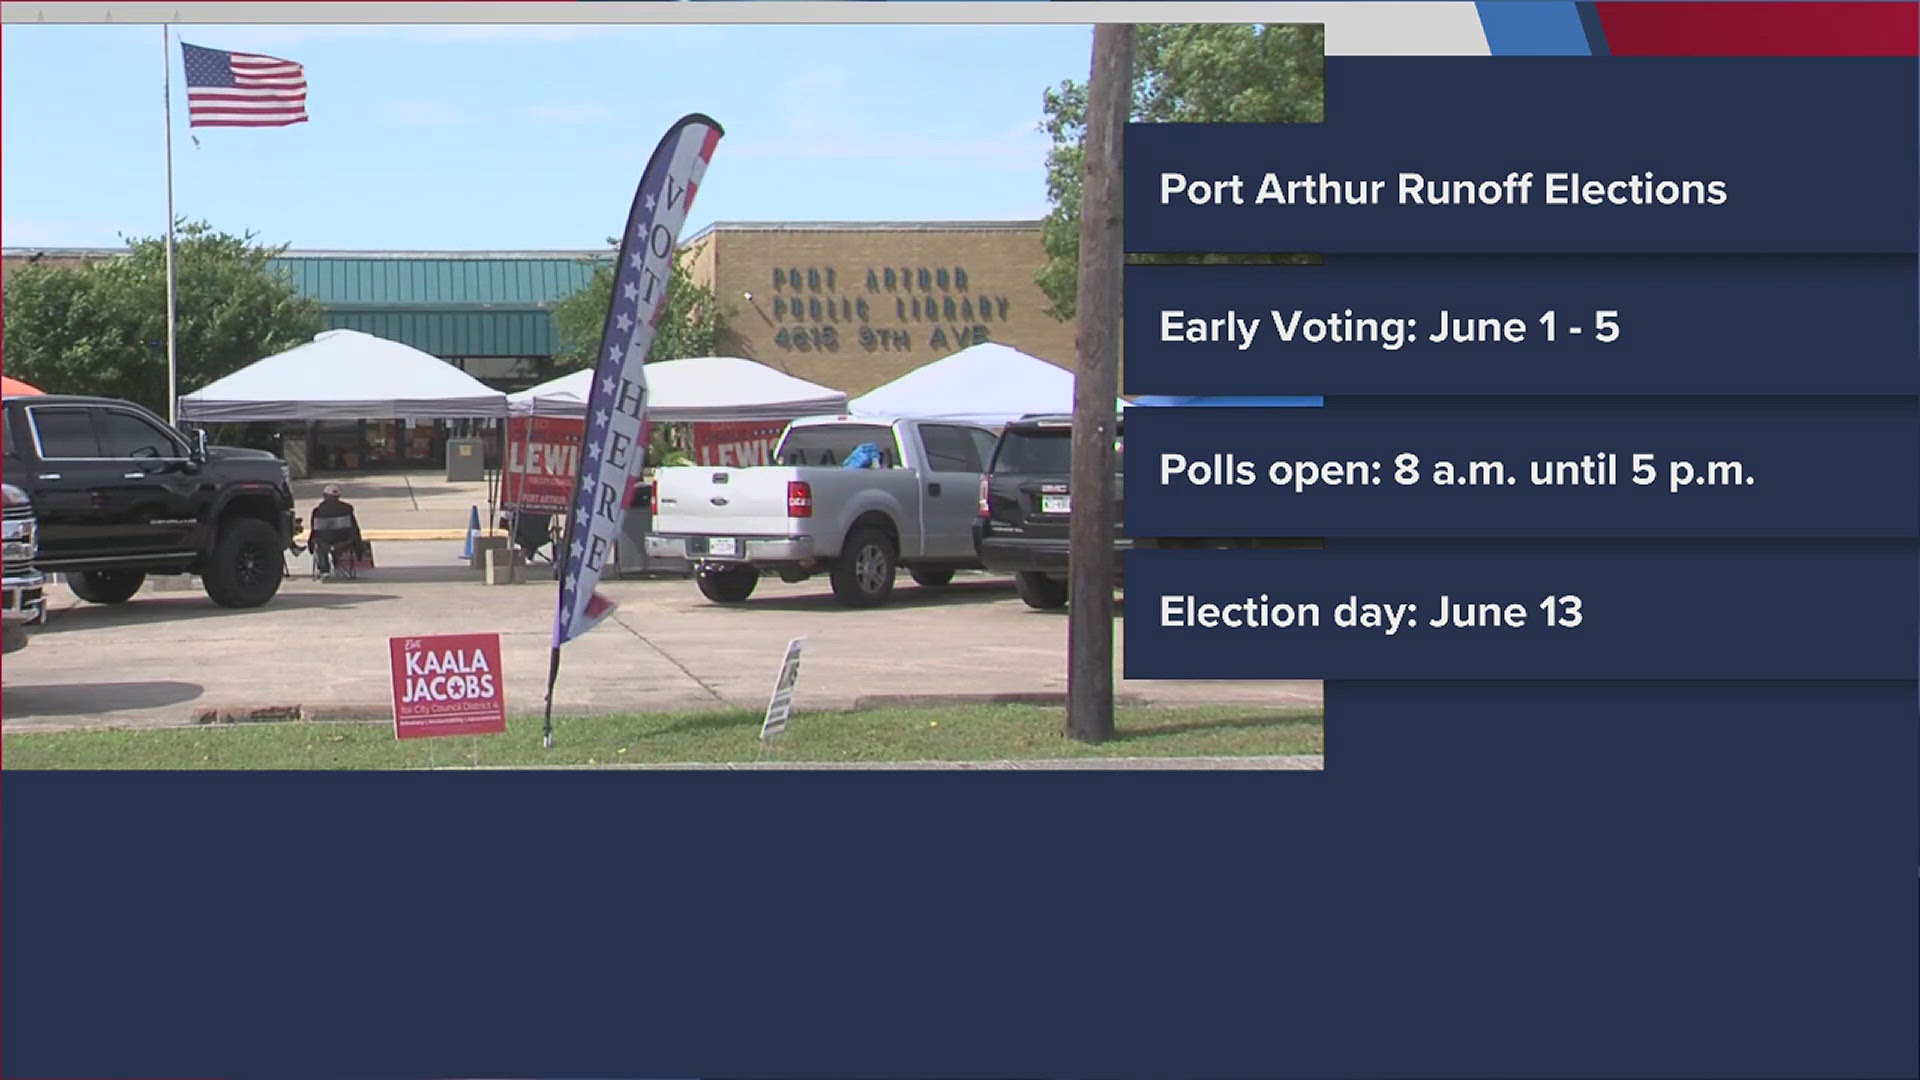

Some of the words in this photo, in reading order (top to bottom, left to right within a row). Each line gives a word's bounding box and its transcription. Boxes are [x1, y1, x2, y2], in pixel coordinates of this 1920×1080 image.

[773, 267, 836, 293] PORT
[866, 267, 969, 293] ARTHUR
[773, 296, 870, 323] PUBLIC
[896, 296, 1010, 323] LIBRARY
[858, 325, 912, 352] 9TH
[585, 378, 647, 573] HERE
[405, 649, 489, 676] KAALA
[402, 674, 495, 703] JACOBS
